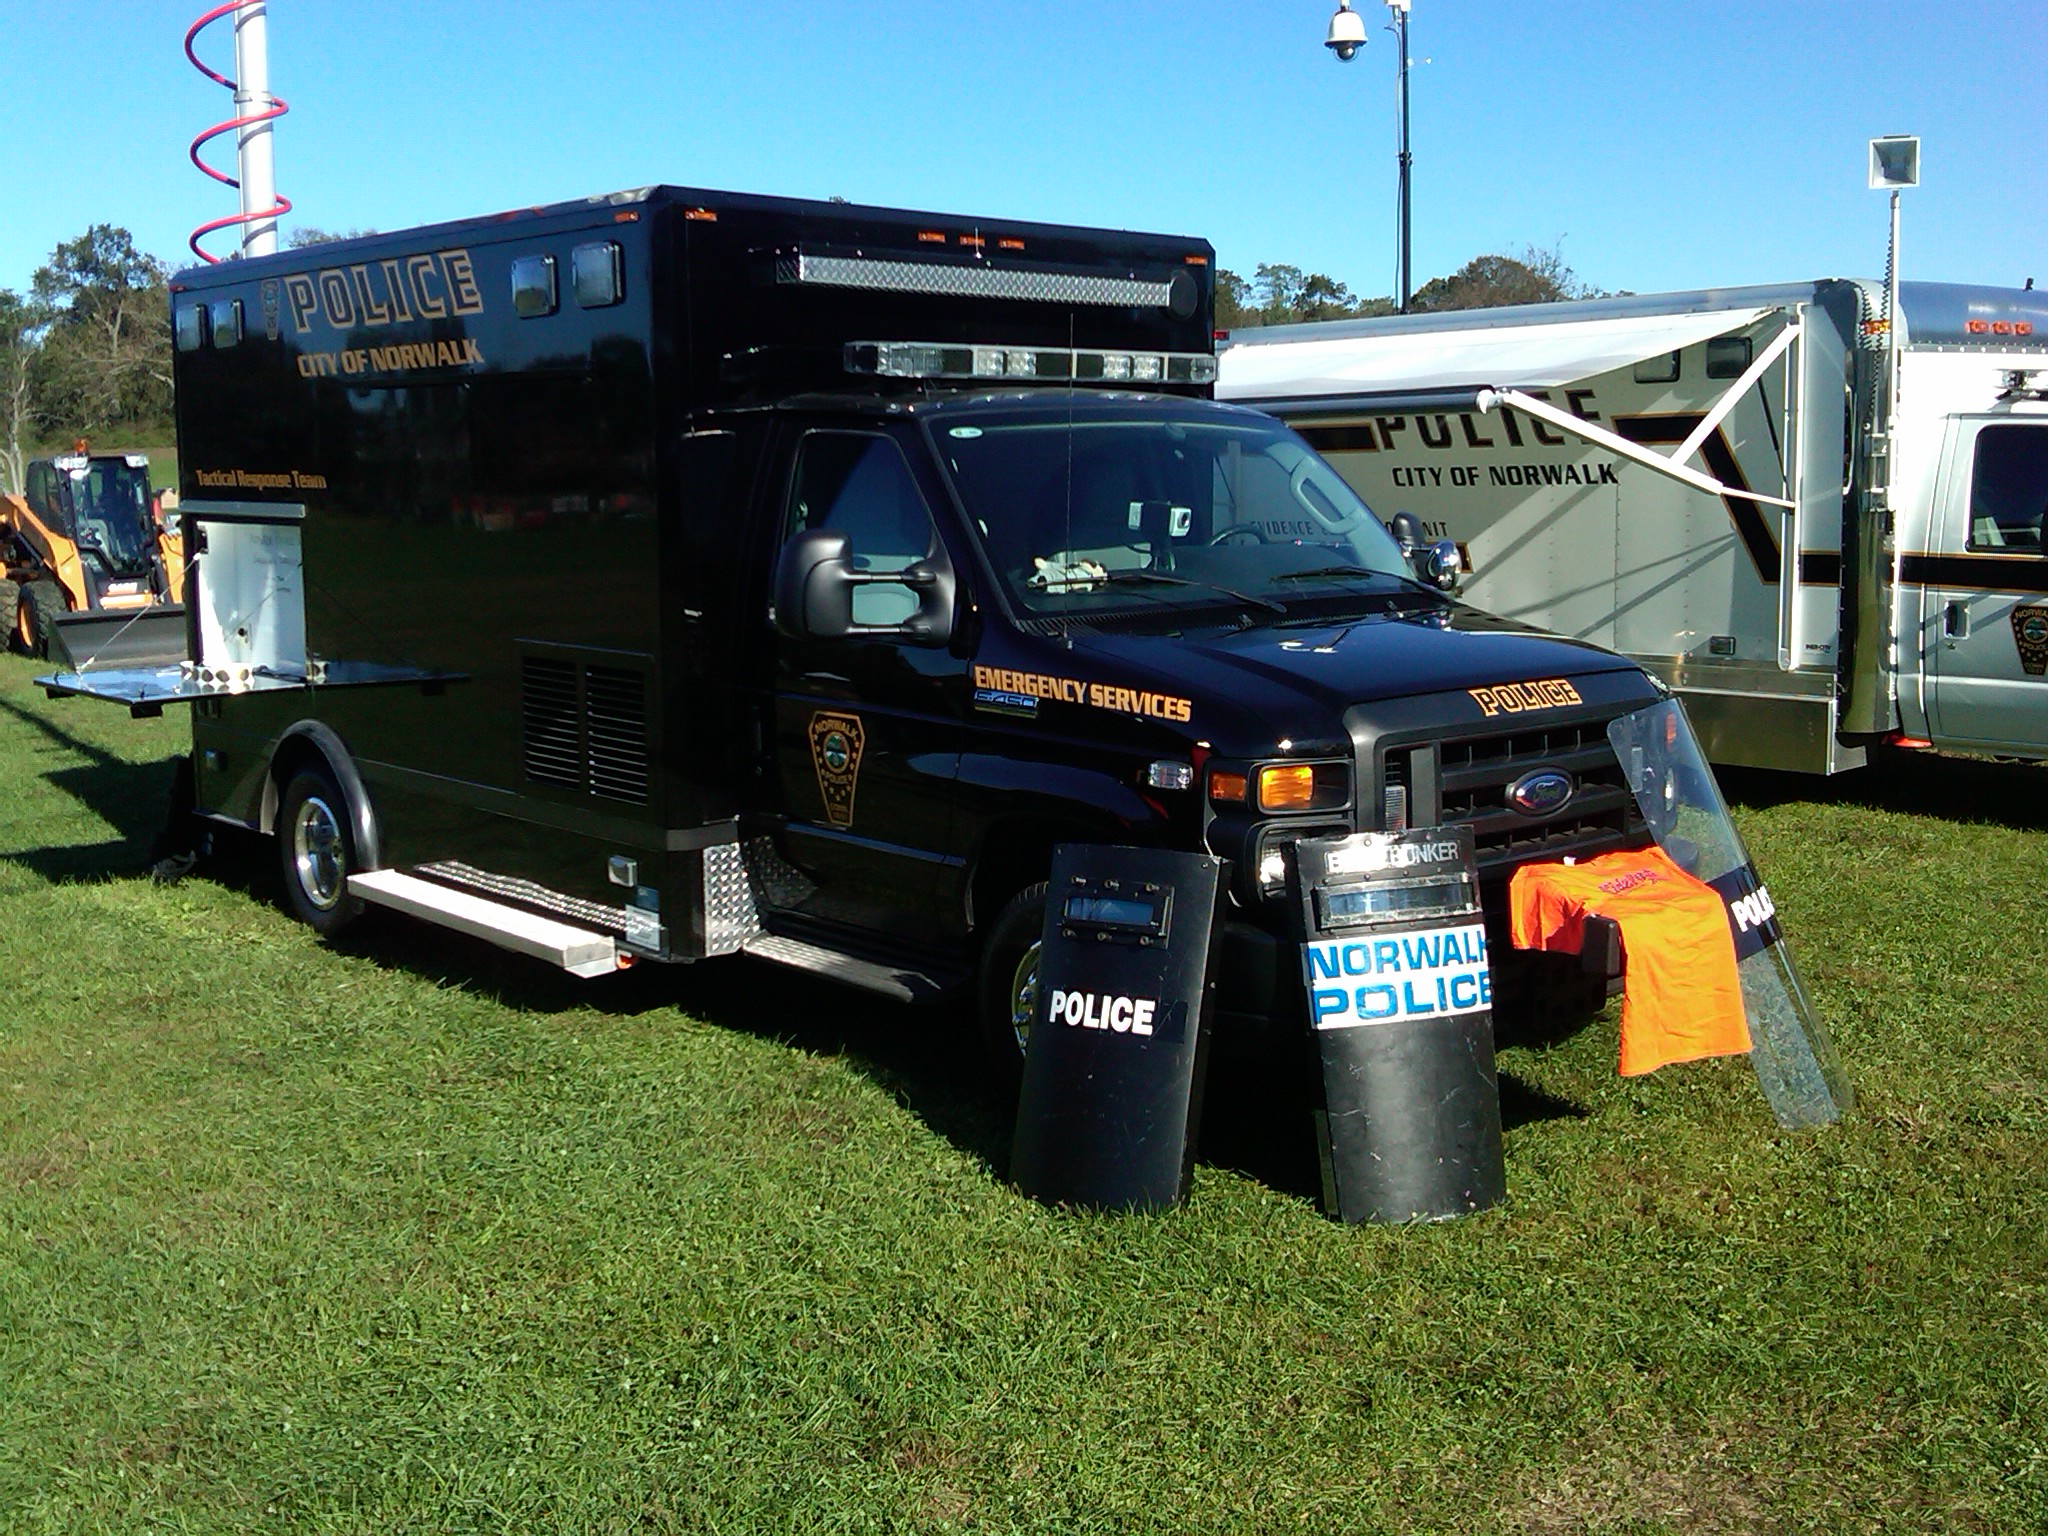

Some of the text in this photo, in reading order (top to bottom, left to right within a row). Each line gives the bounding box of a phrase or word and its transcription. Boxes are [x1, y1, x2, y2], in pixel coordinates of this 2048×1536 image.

[284, 249, 484, 333] POLICE
[297, 338, 485, 378] CITY OF NORWALK
[195, 469, 327, 490] Tactical Response Team
[1392, 463, 1618, 487] CITY OF NORWALK
[2015, 609, 2048, 618] NORWA
[974, 666, 1192, 722] EMERGENCY SERVICES
[1467, 679, 1583, 717] POLICE
[1049, 990, 1155, 1036] POLICE
[1312, 970, 1491, 1028] POLICE
